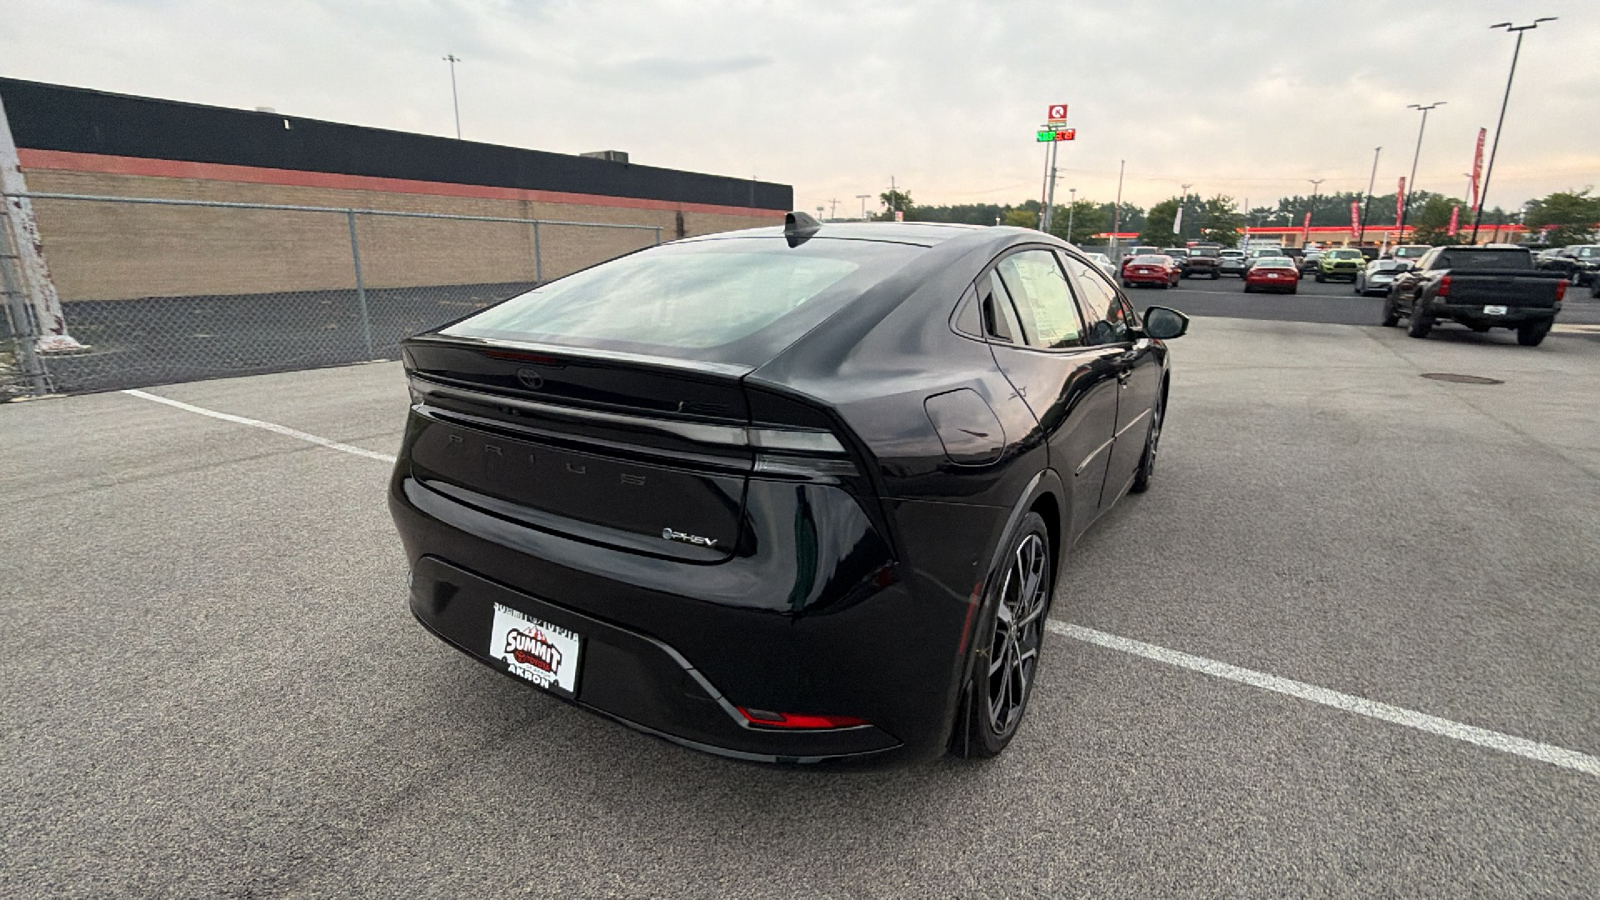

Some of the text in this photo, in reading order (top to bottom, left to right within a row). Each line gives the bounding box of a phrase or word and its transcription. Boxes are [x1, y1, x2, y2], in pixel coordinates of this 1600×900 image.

[449, 434, 646, 486] PRIUS
[671, 530, 718, 546] PHEV
[506, 630, 561, 673] SUMMIT
[507, 663, 550, 689] AKRON
